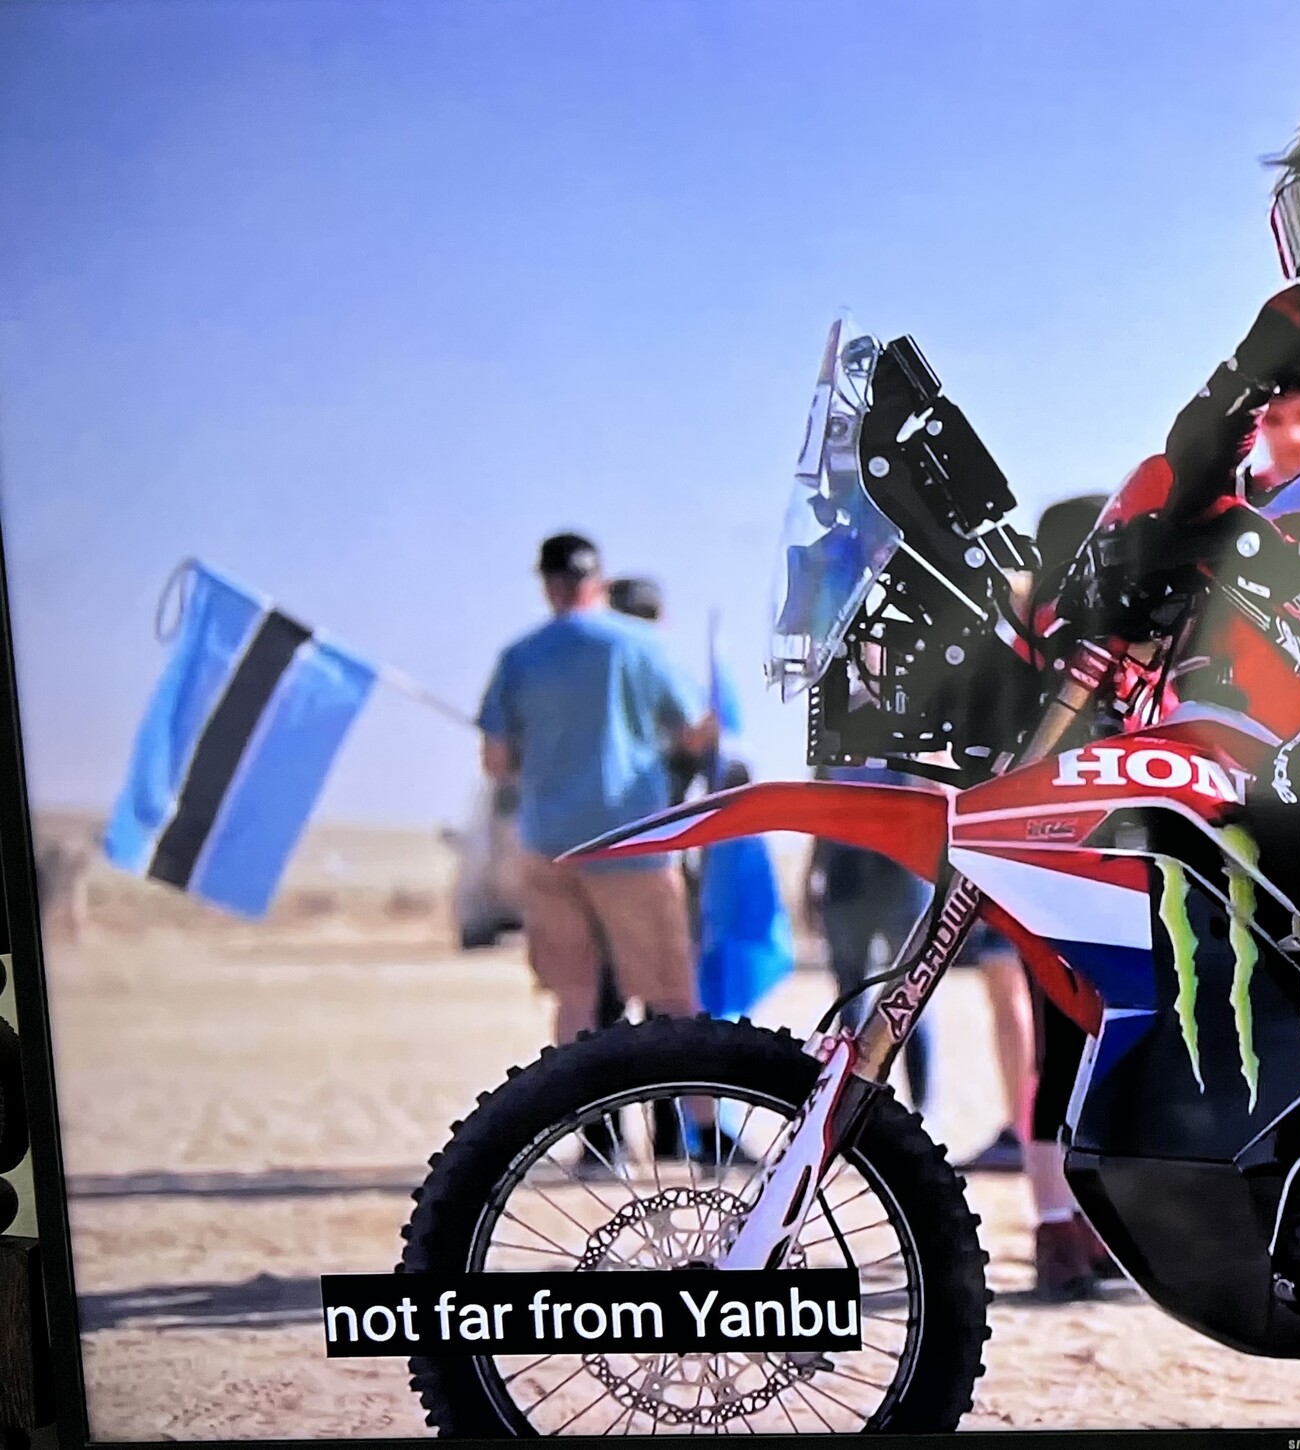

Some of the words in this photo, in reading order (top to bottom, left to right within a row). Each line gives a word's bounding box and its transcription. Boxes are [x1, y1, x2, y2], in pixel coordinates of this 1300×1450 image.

[1052, 748, 1257, 805] HON
[326, 1296, 420, 1342] not
[434, 1290, 512, 1341] far
[528, 1289, 664, 1339] from
[679, 1286, 859, 1339] Yanbu
